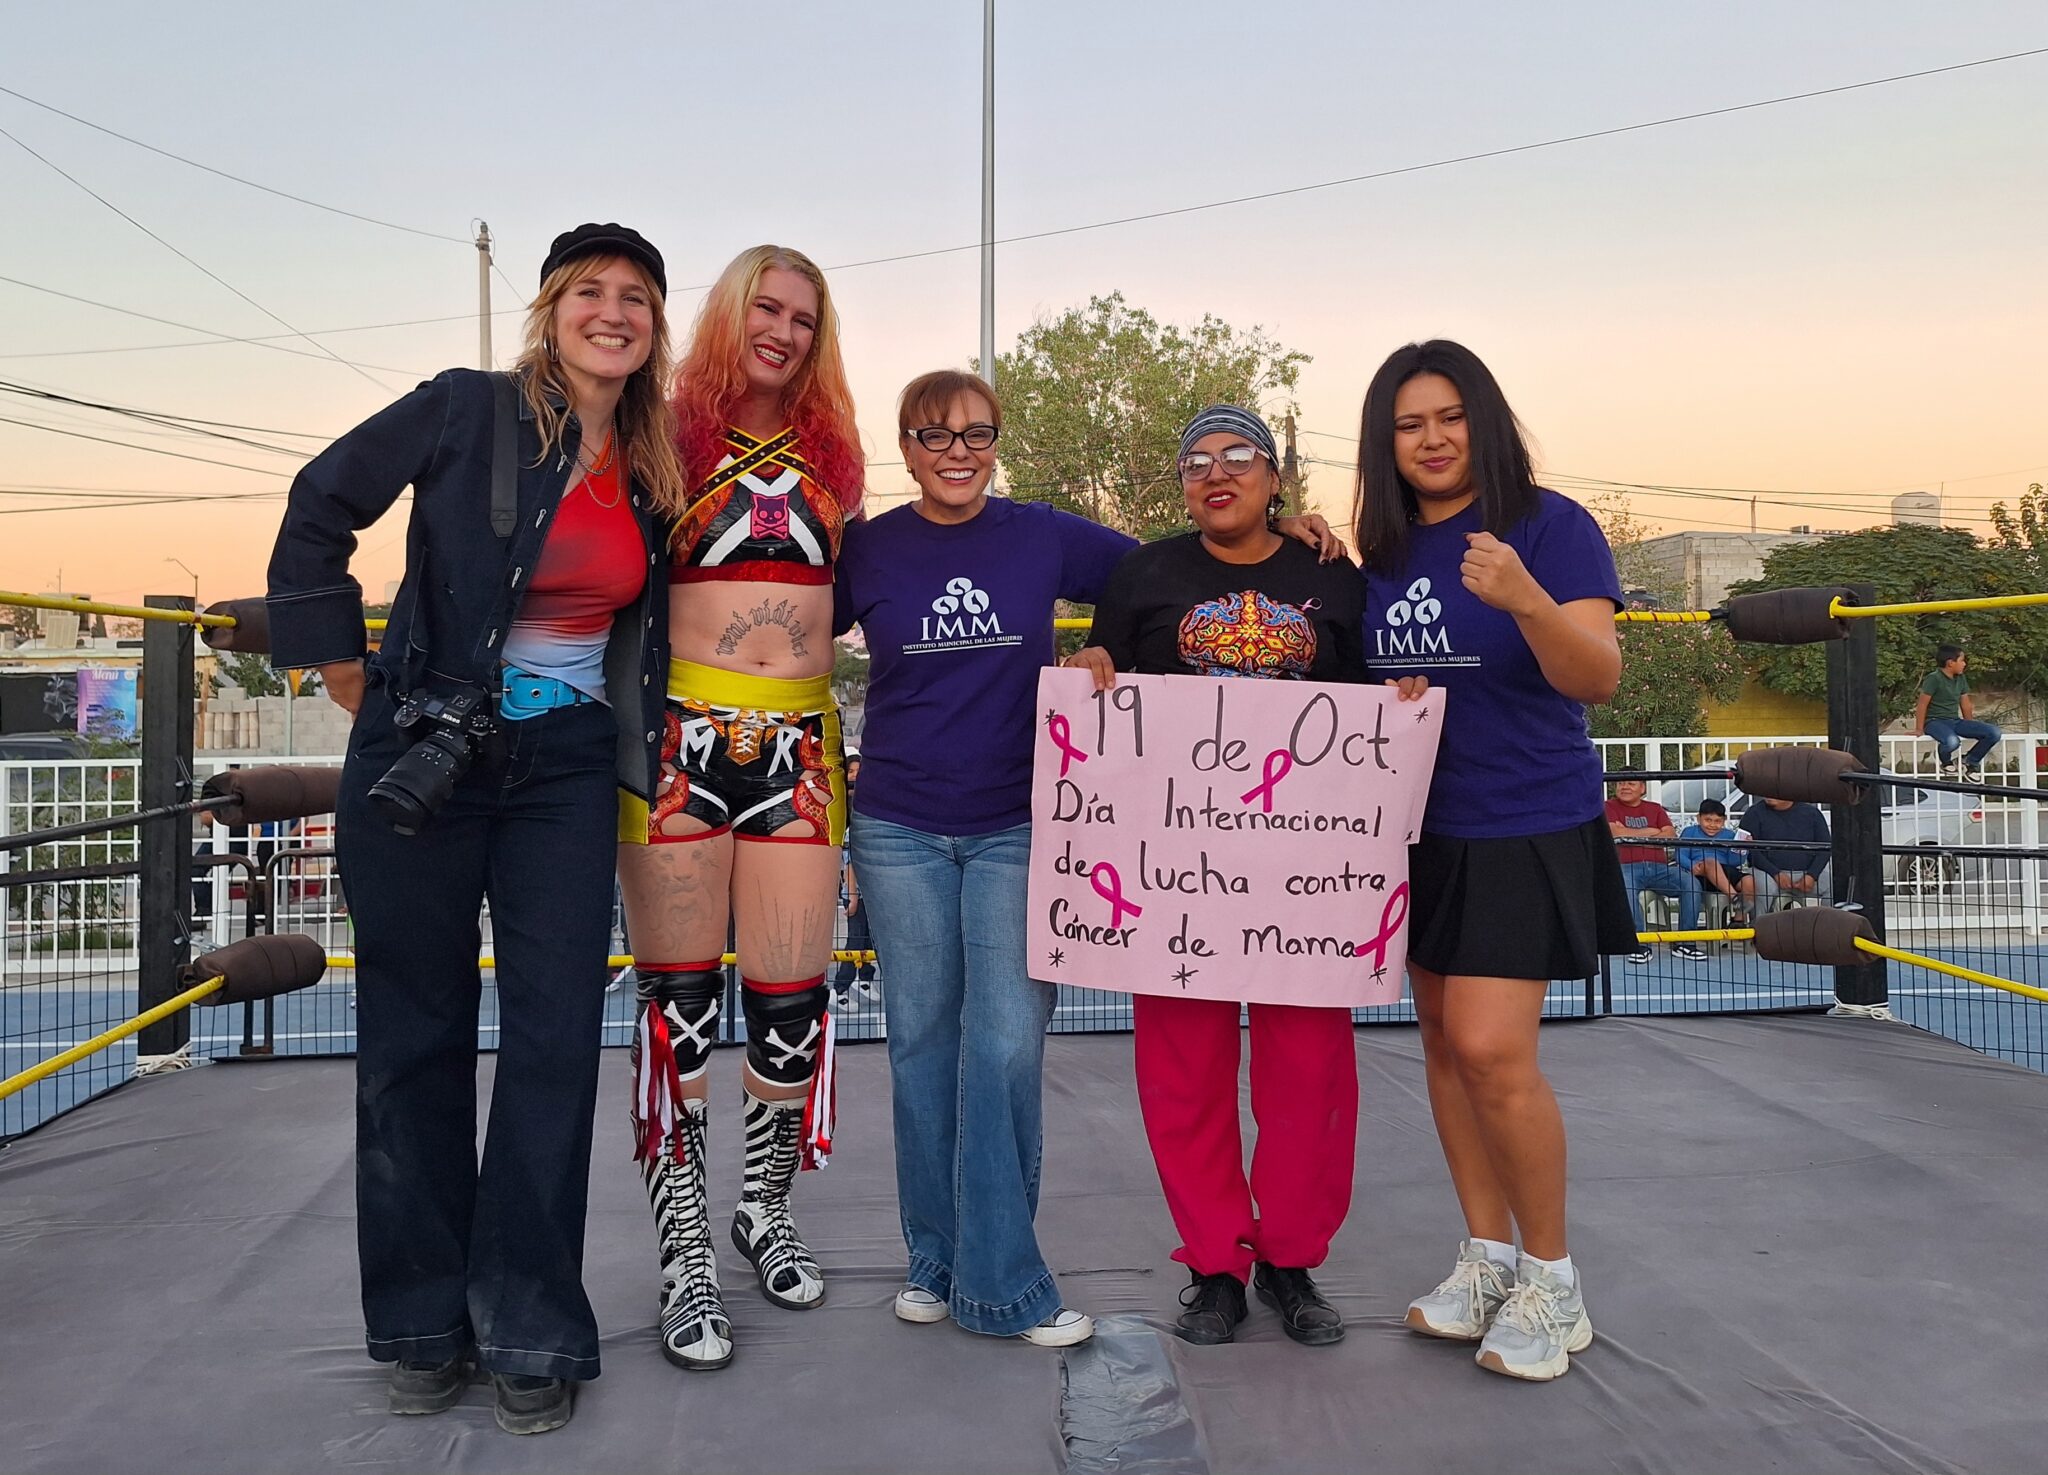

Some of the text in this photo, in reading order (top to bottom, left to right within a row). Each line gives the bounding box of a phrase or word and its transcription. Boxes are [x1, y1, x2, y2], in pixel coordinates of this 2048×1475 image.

[920, 611, 1004, 641] IMM
[1374, 625, 1455, 656] IMM
[902, 642, 937, 651] INSTITUTO
[937, 639, 974, 648] MUNICIPAL
[1447, 655, 1481, 664] MUJERES
[441, 713, 461, 723] Nikon
[1091, 684, 1398, 775] 19 de Oct.
[1052, 777, 1382, 839] Día Internacional
[1054, 840, 1387, 897] de lucha contra
[1049, 898, 1138, 949] Cáncer
[1168, 913, 1219, 958] de
